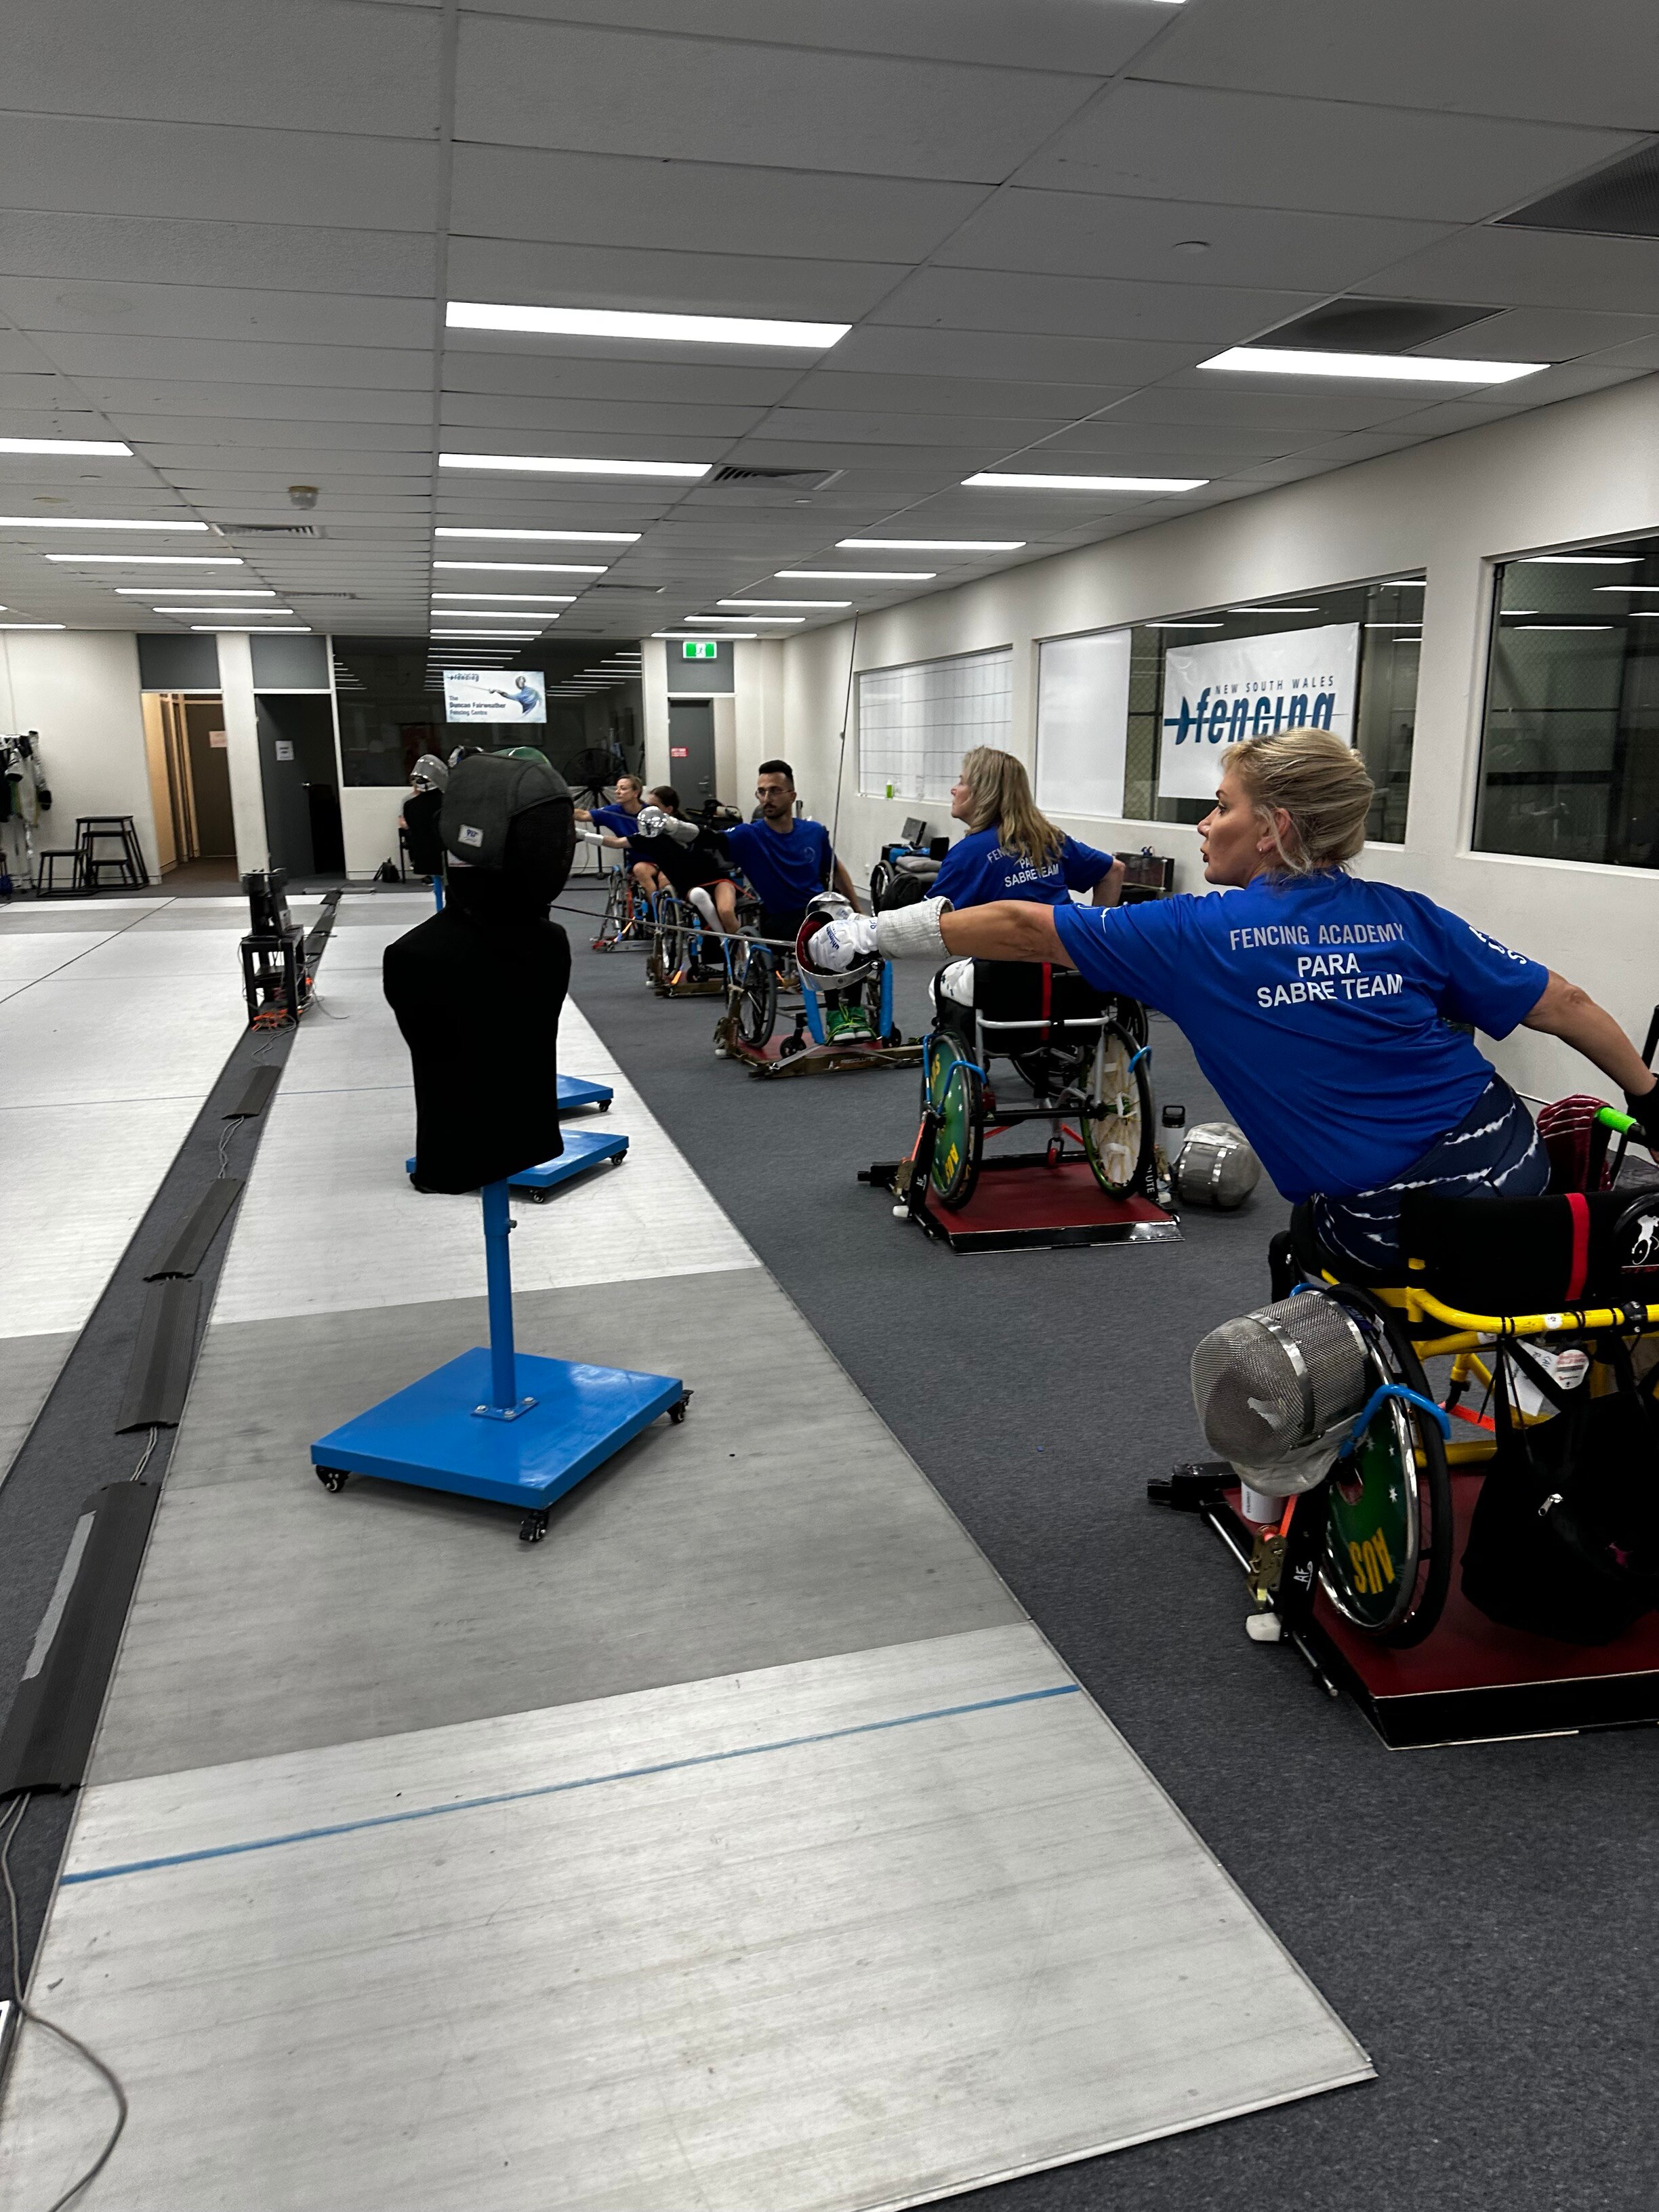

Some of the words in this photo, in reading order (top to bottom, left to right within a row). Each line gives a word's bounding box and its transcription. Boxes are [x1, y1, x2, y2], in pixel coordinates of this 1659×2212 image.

[1216, 683, 1237, 695] NEW
[1246, 680, 1283, 693] SOUTH
[1292, 675, 1334, 689] WALES
[1004, 869, 1038, 888] SABRE
[1230, 925, 1309, 951] FENCING
[1319, 922, 1405, 945] ACADEMY
[1298, 953, 1361, 977] PARA
[1257, 981, 1337, 1008] SABRE
[1342, 974, 1403, 1000] TEAM
[1349, 1527, 1396, 1595] AUS
